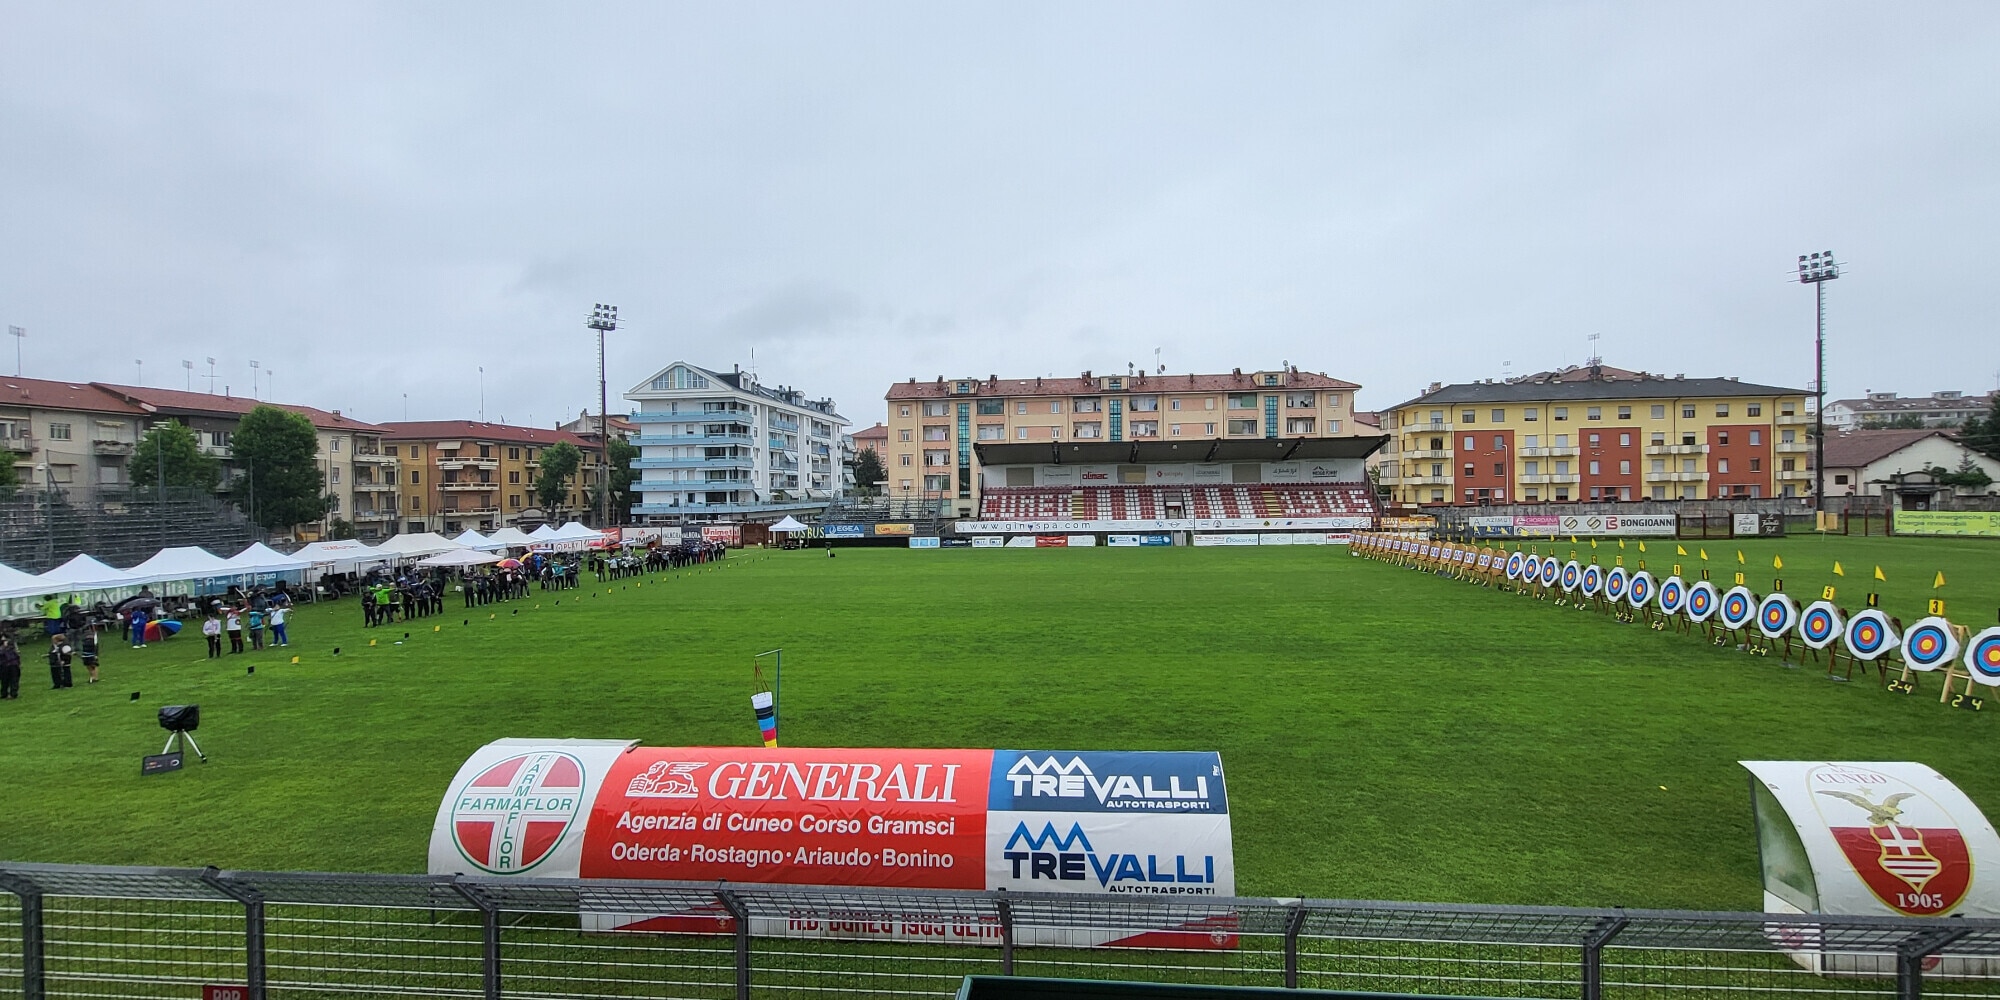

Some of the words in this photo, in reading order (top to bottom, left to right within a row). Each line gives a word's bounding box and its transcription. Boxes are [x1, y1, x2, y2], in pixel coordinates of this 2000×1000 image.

[837, 524, 860, 532] EGEA
[970, 522, 1091, 531] www.ginspa.com
[1620, 519, 1675, 527] BONGIOANNI
[807, 526, 825, 539] BUS
[1824, 587, 1832, 598] 5
[1868, 593, 1875, 606] 4
[1931, 601, 1939, 613] 3
[1750, 645, 1768, 656] 2-4
[1887, 680, 1913, 694] 2-4
[708, 761, 962, 803] GENERALI
[1816, 773, 1887, 784] CUNEO
[1006, 774, 1209, 805] TREVALLI
[460, 798, 573, 811] FARMAFLOR
[1106, 800, 1211, 810] AUTOTRASPORTI
[616, 811, 697, 834] Agenzia
[702, 813, 723, 831] di
[727, 813, 793, 833] Cuneo
[799, 814, 861, 834] Corso
[867, 815, 955, 836] Gramsci
[882, 848, 954, 868] Bonino
[1004, 851, 1215, 888] TREVALLI
[1108, 885, 1215, 896] AUTOTRASPORTI
[1896, 893, 1944, 909] 1905
[951, 914, 1004, 938] OLM
